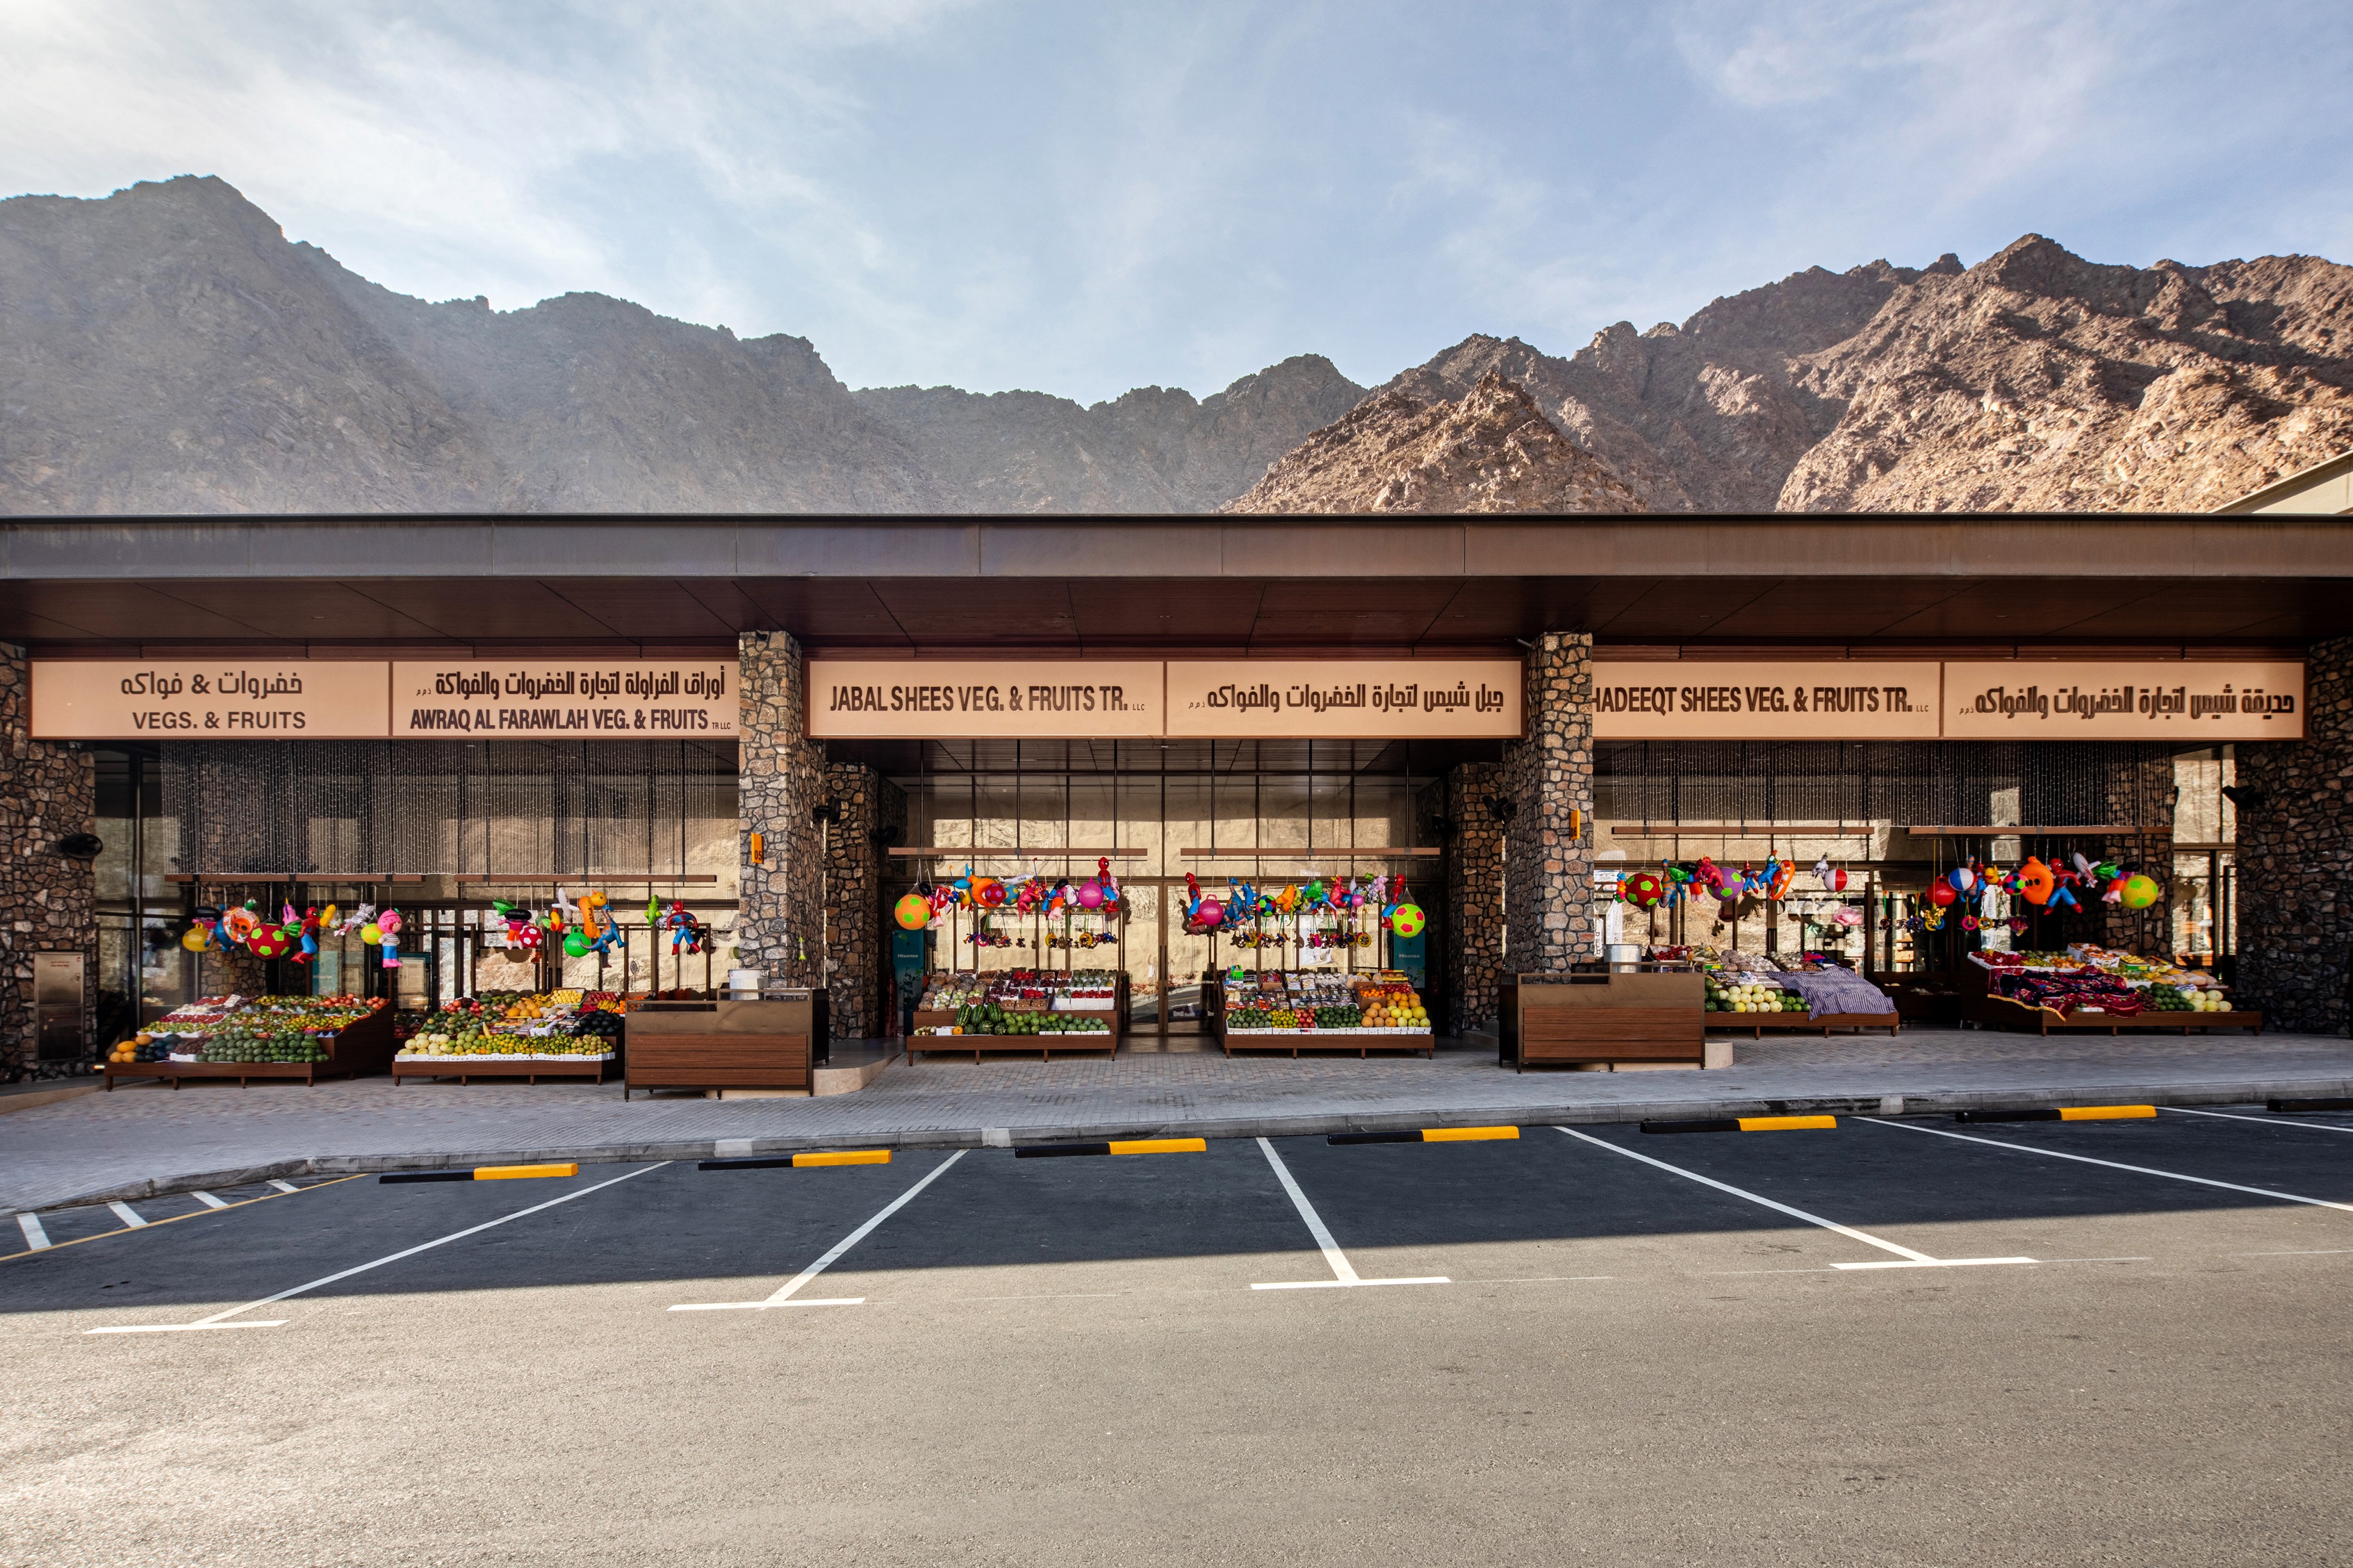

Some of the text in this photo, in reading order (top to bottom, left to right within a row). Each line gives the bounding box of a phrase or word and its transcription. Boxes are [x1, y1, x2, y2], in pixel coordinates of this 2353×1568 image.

[122, 670, 302, 700] خضروات & فواكه
[436, 671, 499, 700] والفواكة
[505, 671, 575, 700] الخضروات
[580, 671, 620, 700] لتجارة
[625, 671, 679, 700] الفراولة
[684, 666, 725, 700] أوراق
[1424, 681, 1470, 713] شيص
[830, 686, 888, 711] JABAL
[891, 686, 953, 711] SHEES
[958, 686, 1005, 711] VEG.
[1010, 686, 1023, 711] &
[1029, 686, 1095, 711] FRUITS
[1099, 686, 1128, 711] TR.
[1208, 684, 1279, 713] والفواكه
[1286, 684, 1366, 713] الخضروات
[1372, 684, 1418, 713] لتجارة
[1475, 684, 1504, 713] جبل
[1681, 686, 1741, 712] SHEES
[1745, 686, 1789, 712] VEG.
[1794, 686, 1808, 712] &
[1813, 686, 1879, 712] FRUITS
[1883, 687, 1912, 712] TR.
[1975, 686, 2049, 719] والفواكه
[2053, 686, 2133, 719] الخضروات
[2139, 686, 2186, 720] لتجارة
[2190, 684, 2237, 720] شيص
[2241, 688, 2295, 720] حديقة
[132, 711, 306, 729] VEGS. & FRUITS
[410, 709, 470, 732] AWRAQ
[474, 709, 495, 729] AL
[499, 709, 588, 729] FARAWLAH
[592, 709, 630, 729] VEG.
[634, 709, 646, 729] &
[651, 709, 708, 729] FRUITS
[755, 850, 762, 860] 05
